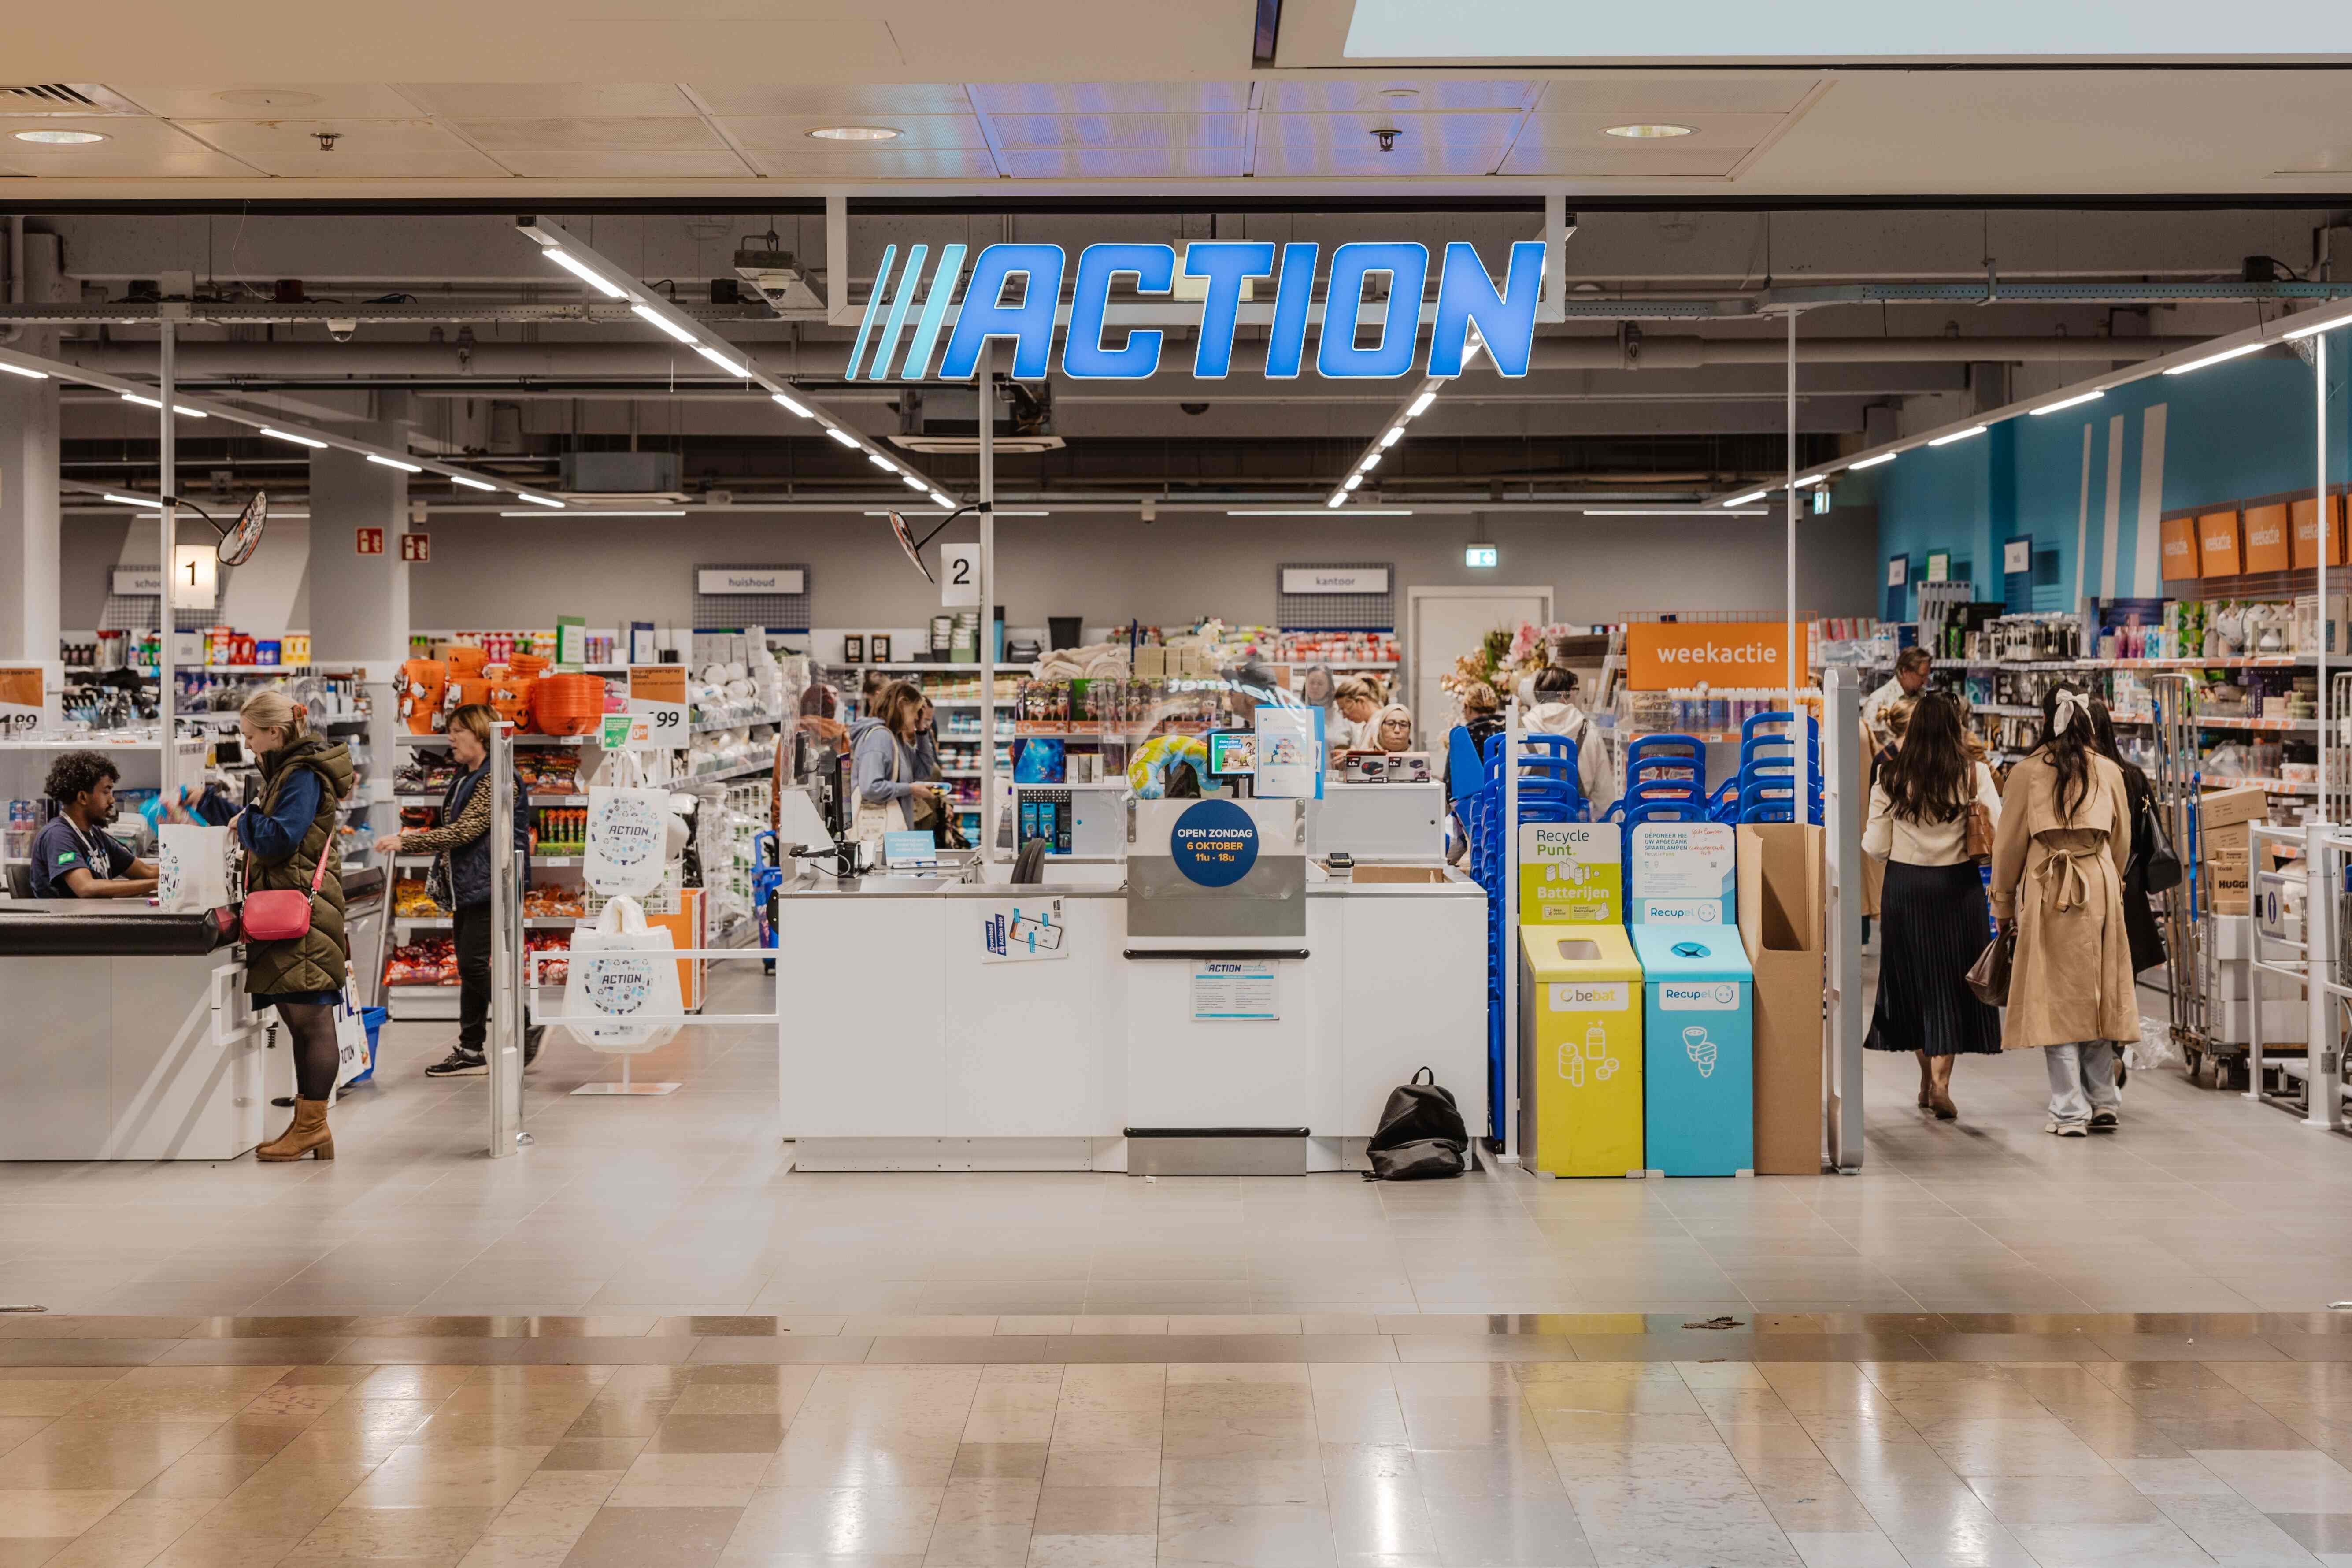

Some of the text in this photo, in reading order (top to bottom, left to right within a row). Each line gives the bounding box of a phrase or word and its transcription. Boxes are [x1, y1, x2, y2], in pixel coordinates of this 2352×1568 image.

[937, 242, 1547, 380] ACTION
[185, 561, 196, 586] 1
[952, 558, 970, 585] 2
[728, 577, 775, 588] huishoud
[1315, 576, 1356, 586] kantoor
[1657, 641, 1777, 663] weekactie
[609, 825, 649, 836] ACTION
[1177, 829, 1253, 838] OPEN ZONDAG
[1537, 829, 1589, 845] Recycle
[1186, 842, 1243, 851] 6 OKTOBER
[1537, 844, 1577, 856] Punt.
[1537, 886, 1610, 901] Batterijen
[1651, 908, 1695, 918] Recupel
[602, 974, 641, 985] ACTION
[1575, 990, 1616, 1002] bebat
[1667, 989, 1712, 1001] Recupel
